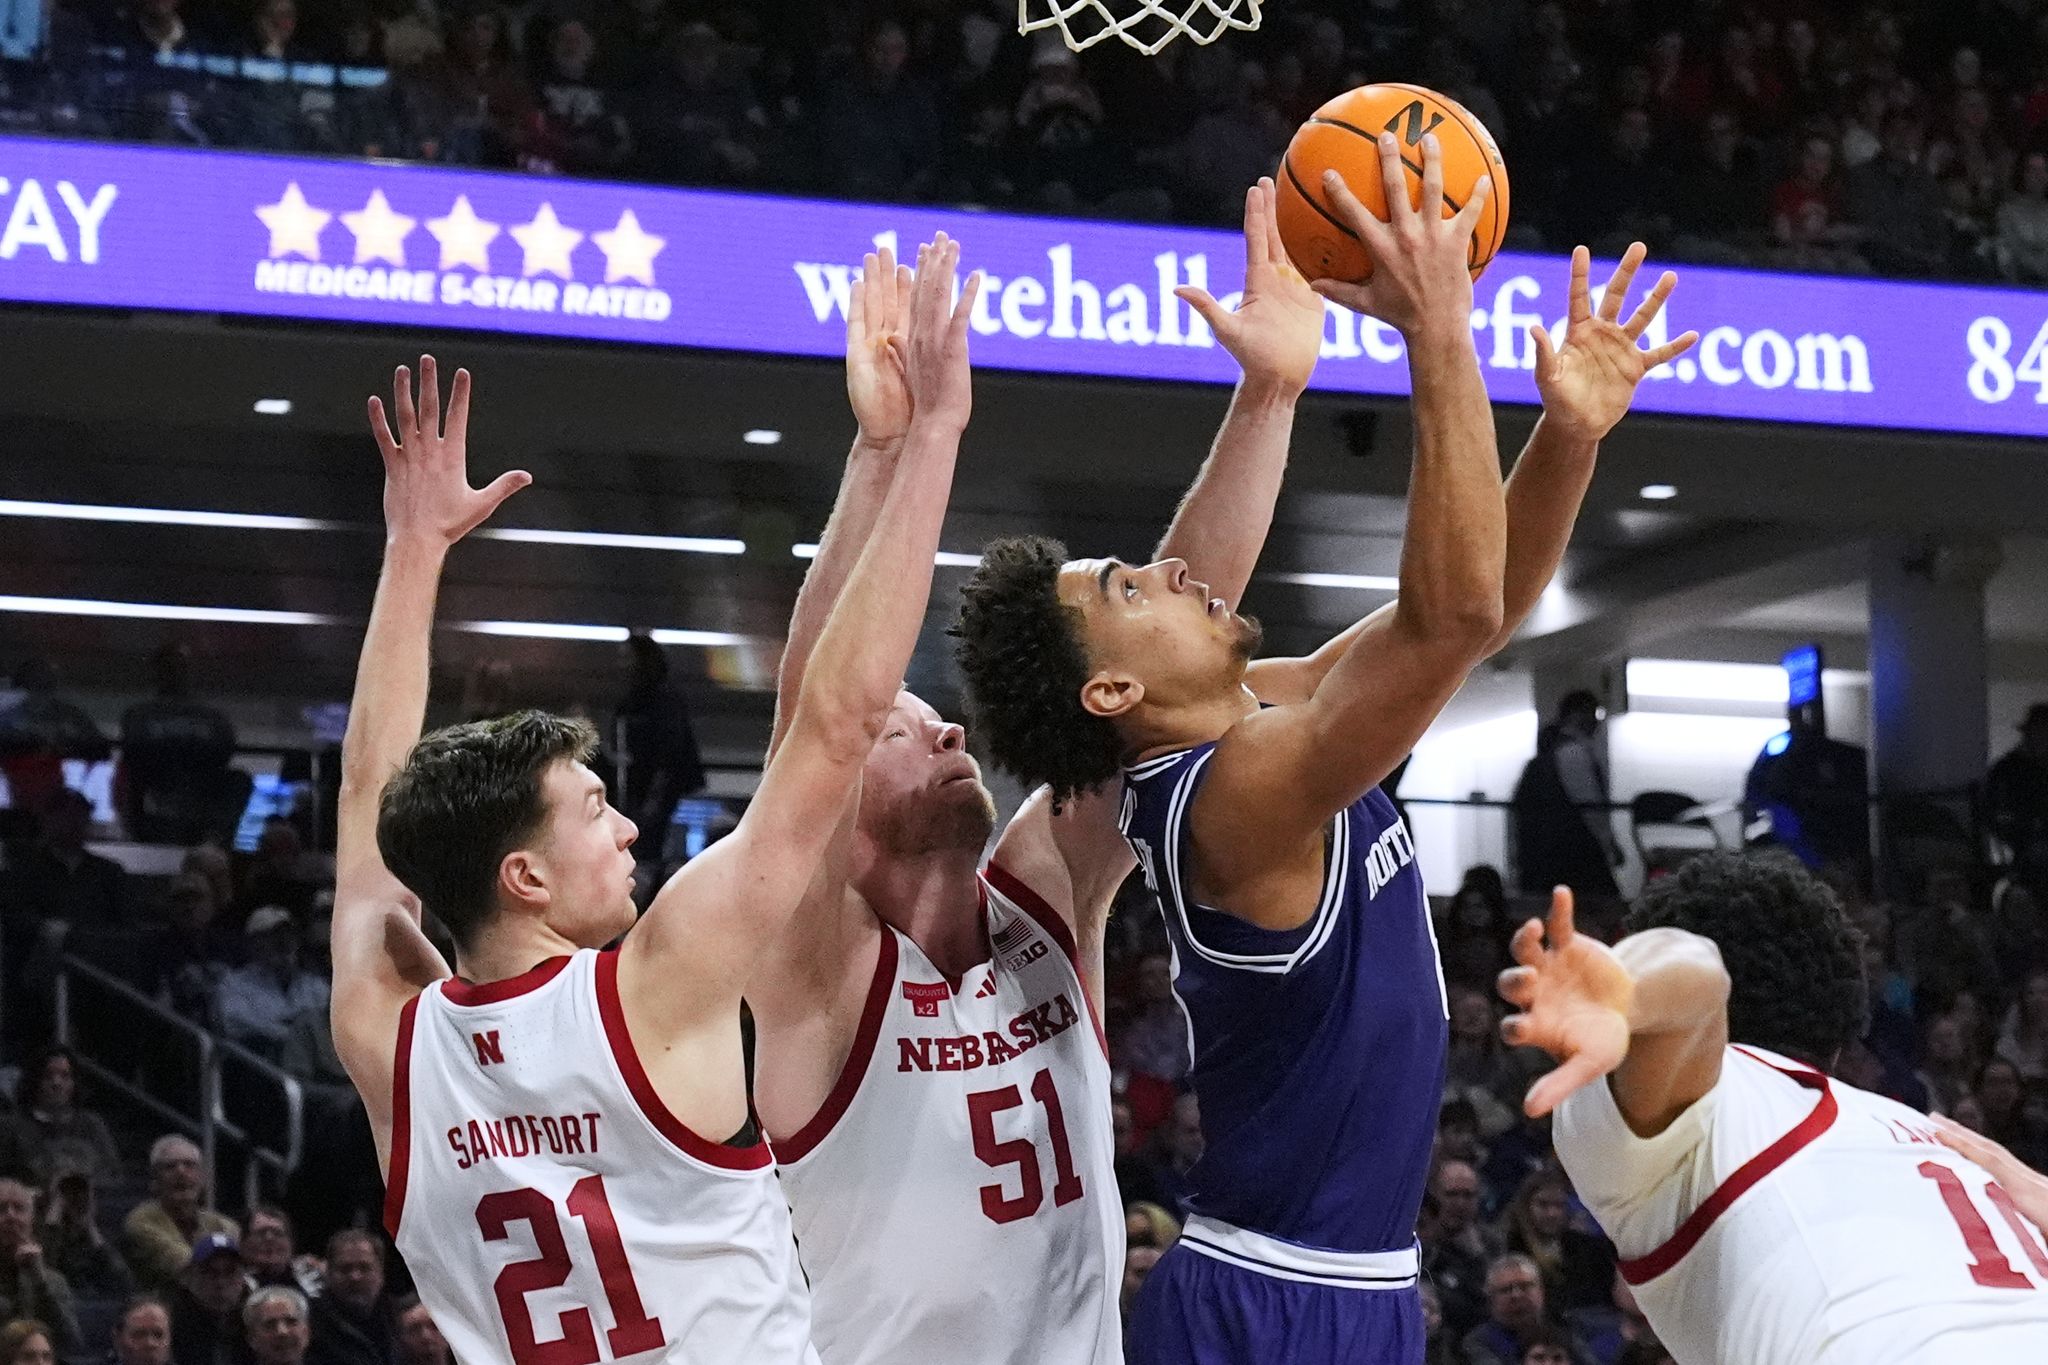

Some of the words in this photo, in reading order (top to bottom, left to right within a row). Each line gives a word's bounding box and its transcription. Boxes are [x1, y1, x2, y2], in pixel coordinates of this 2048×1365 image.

[0, 176, 118, 264] AY
[255, 260, 435, 303] MEDICARE
[441, 273, 559, 312] 5-STAR
[562, 283, 672, 321] RATED
[897, 992, 1079, 1072] NEBRASKA
[917, 1003, 935, 1015] x2
[472, 1030, 505, 1066] N
[447, 1112, 601, 1169] SANDFORT
[966, 1067, 1084, 1225] 51
[474, 1174, 666, 1365] 21
